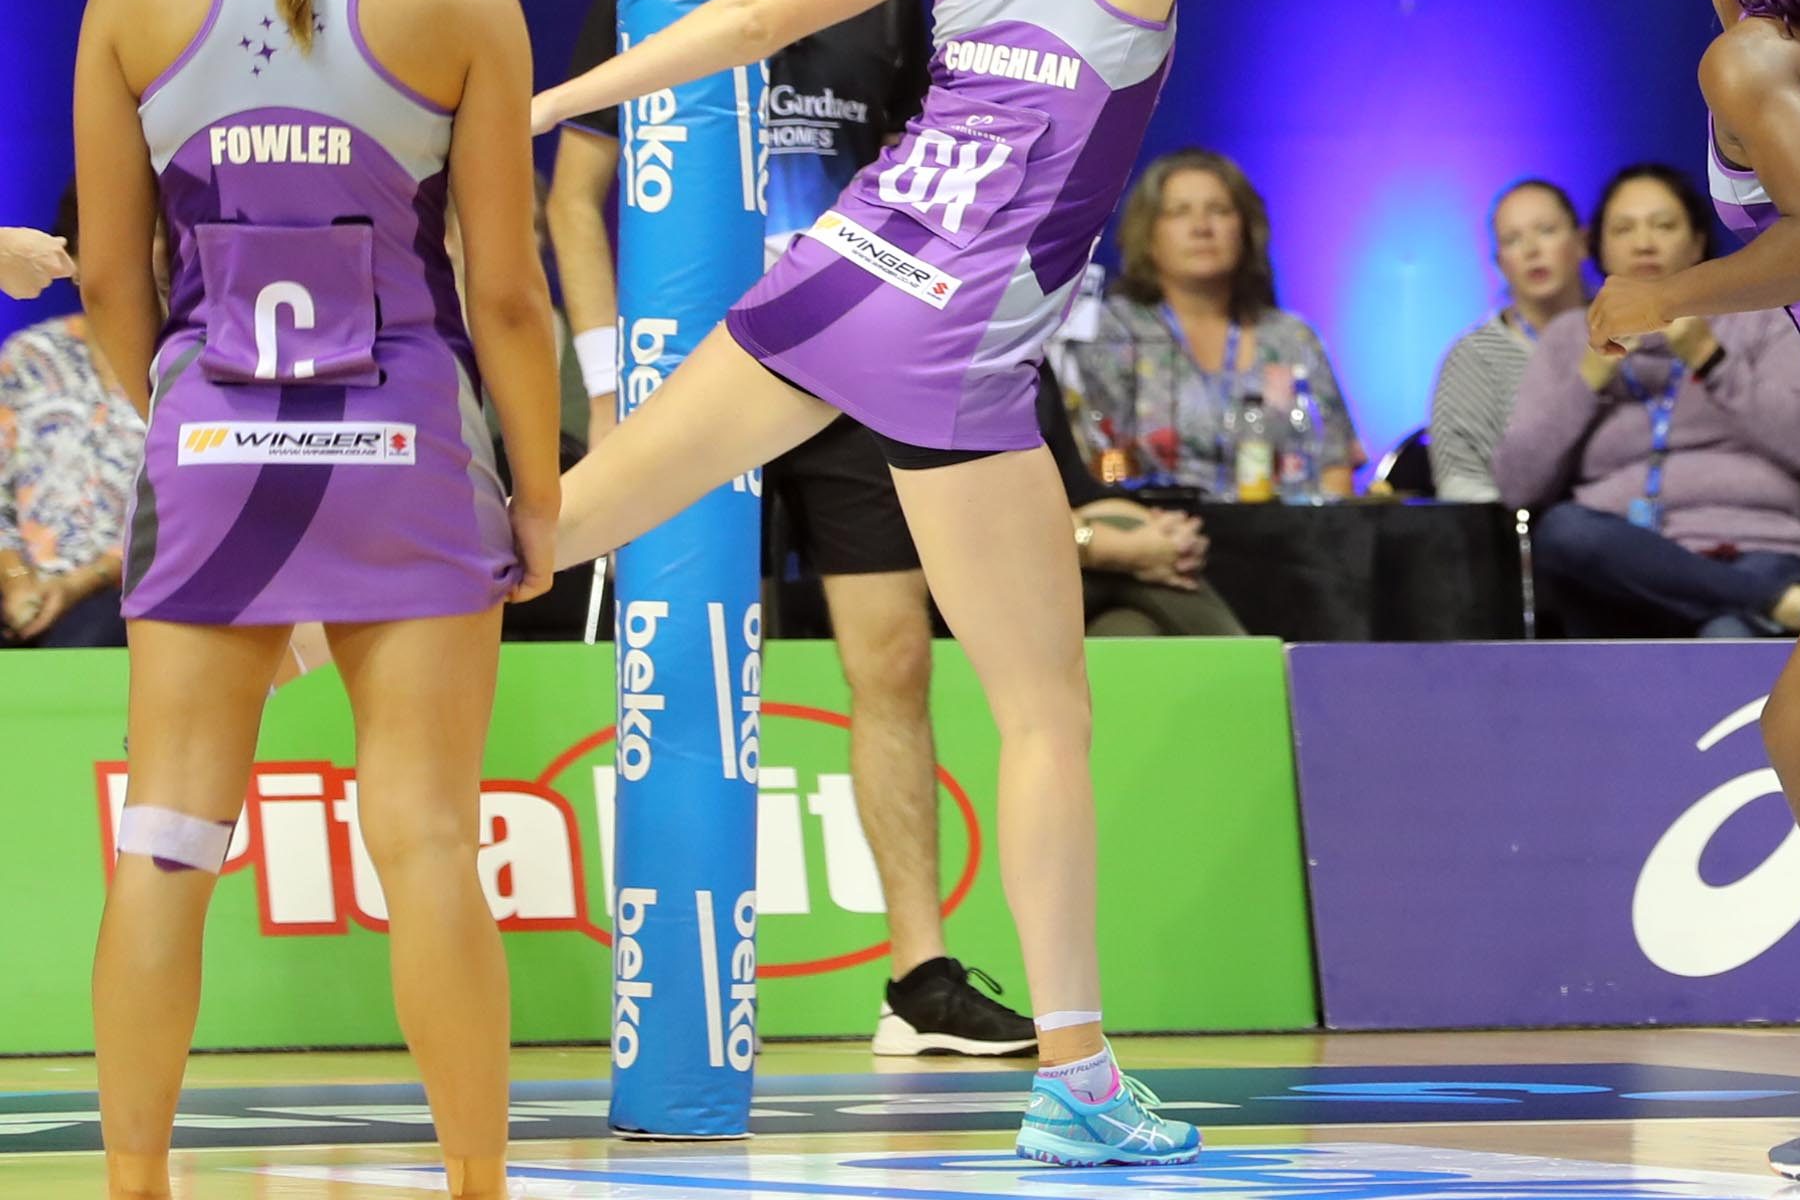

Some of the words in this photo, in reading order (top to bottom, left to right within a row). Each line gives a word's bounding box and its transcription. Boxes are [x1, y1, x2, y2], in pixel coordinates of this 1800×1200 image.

[945, 40, 1081, 90] COUGHLAN
[768, 126, 834, 149] HOMES
[769, 84, 868, 123] Gardner
[209, 125, 351, 166] FOWLER
[634, 84, 688, 214] eko
[878, 129, 1013, 235] GK
[838, 226, 931, 283] WINGER
[628, 318, 678, 412] be
[234, 431, 381, 449] WINGER
[622, 601, 668, 781] beko
[592, 763, 888, 916] it
[613, 888, 657, 1069] beko
